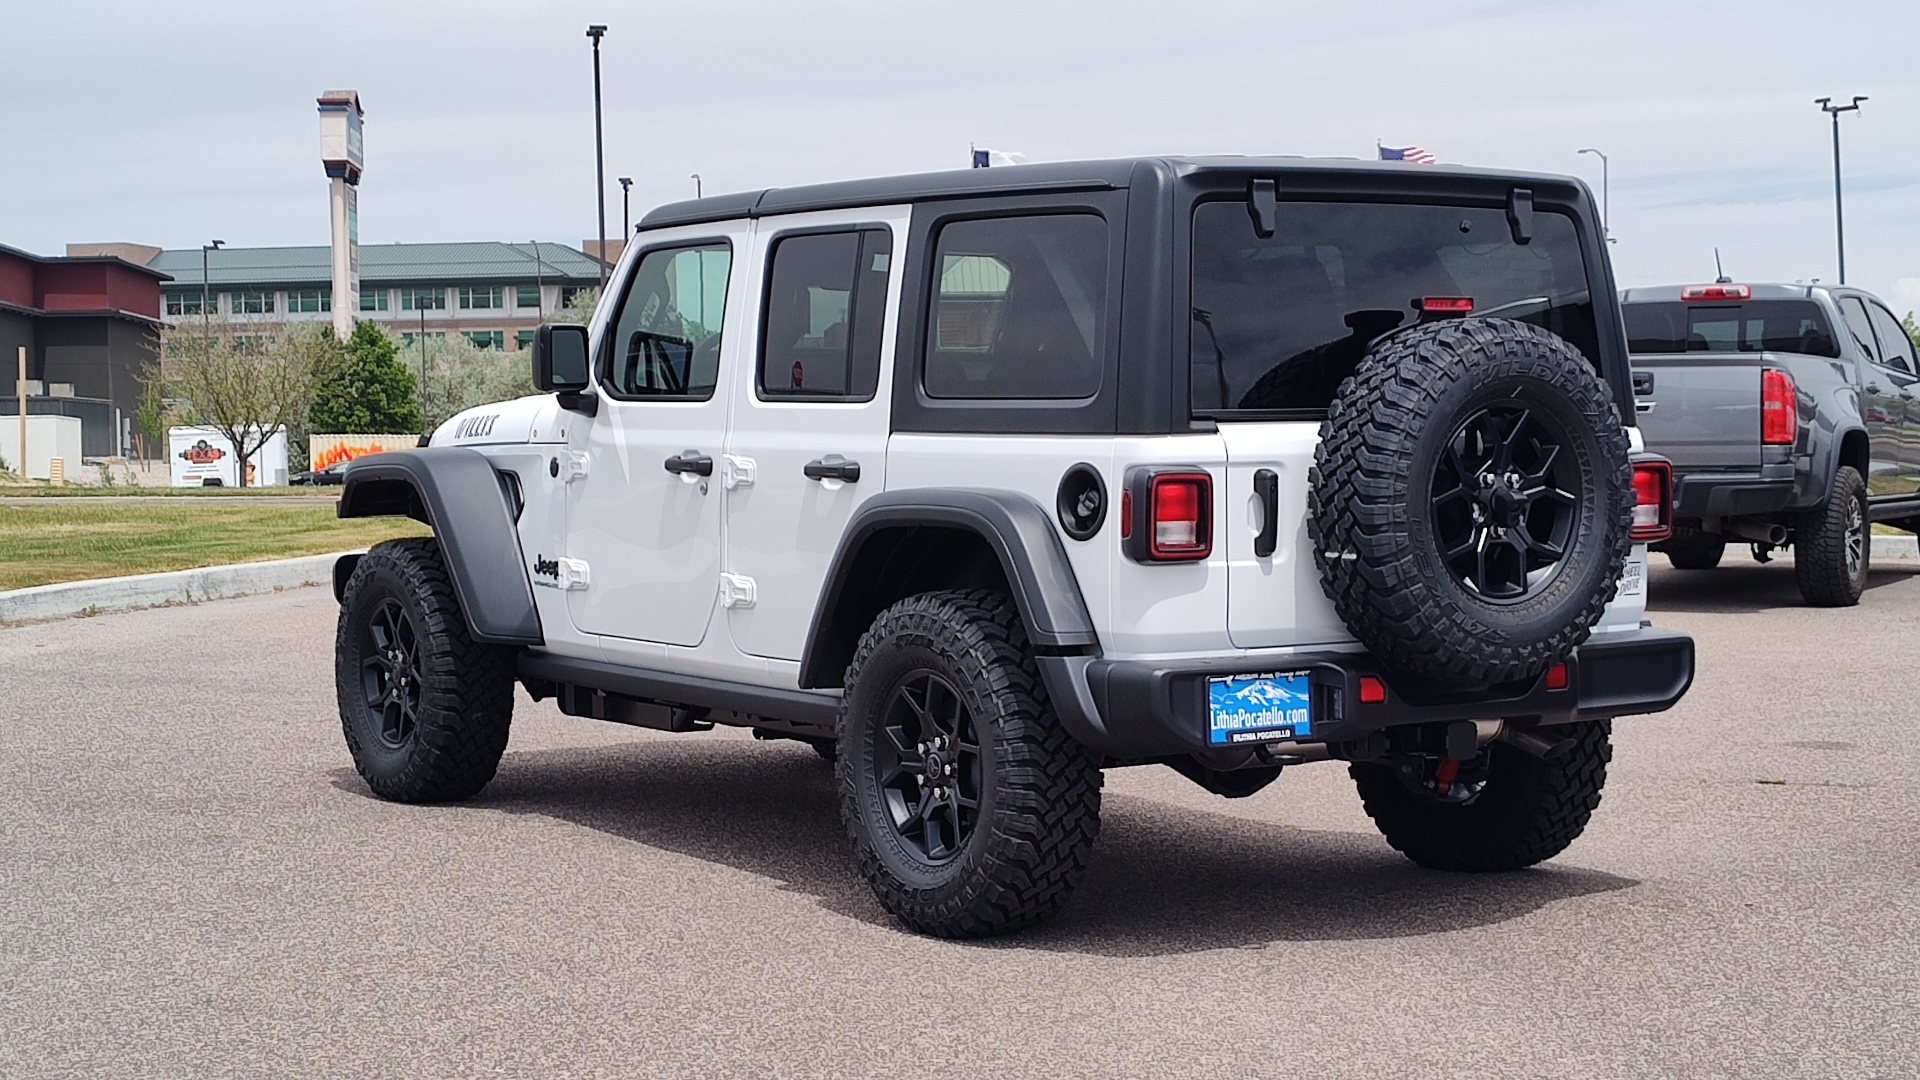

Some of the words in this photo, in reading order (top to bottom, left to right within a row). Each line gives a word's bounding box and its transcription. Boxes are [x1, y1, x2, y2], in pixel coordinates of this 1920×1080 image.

[455, 414, 501, 439] WILLYS
[534, 553, 559, 580] Jeep
[1210, 706, 1308, 730] LithiaPocatello.com
